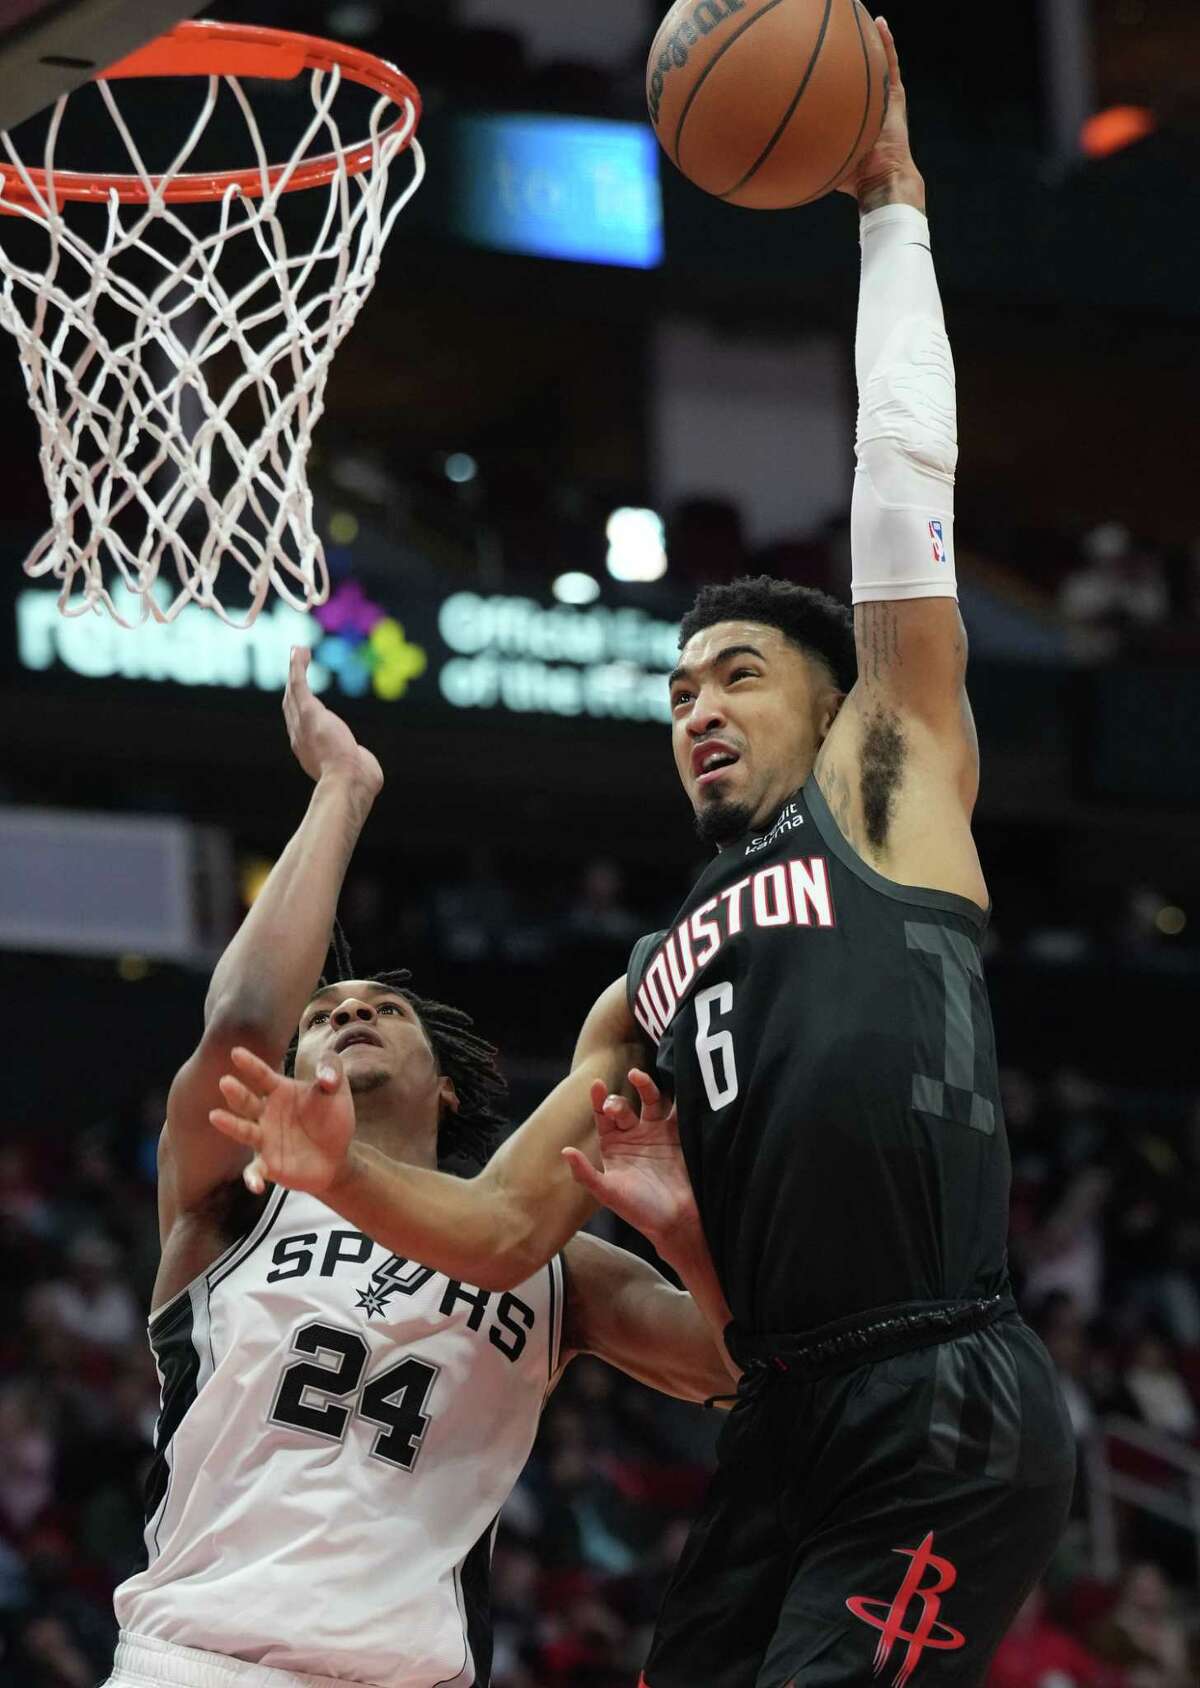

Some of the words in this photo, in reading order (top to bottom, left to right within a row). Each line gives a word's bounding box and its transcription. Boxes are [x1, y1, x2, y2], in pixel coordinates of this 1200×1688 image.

[633, 855, 836, 1047] HOUSTON
[694, 981, 739, 1112] 6
[266, 1320, 442, 1474] 24
